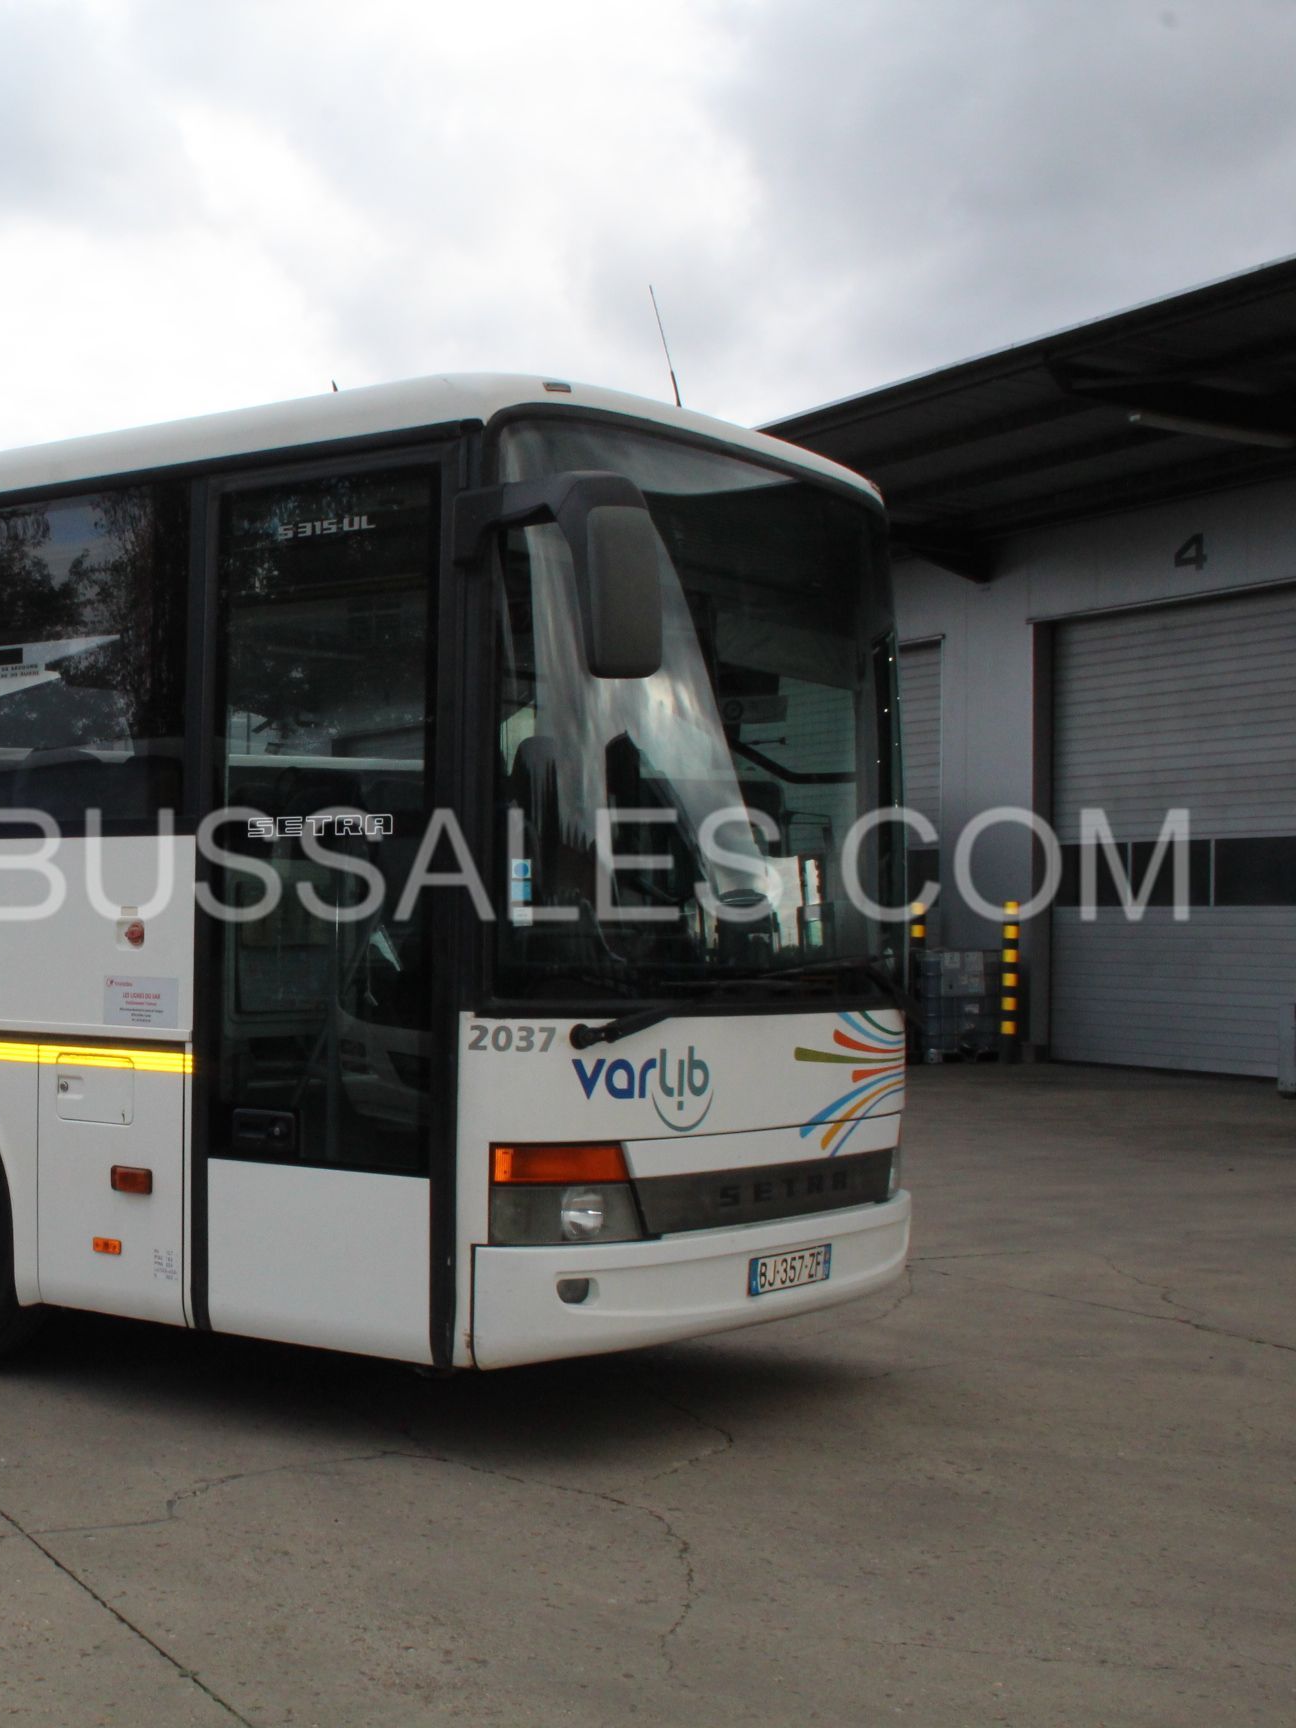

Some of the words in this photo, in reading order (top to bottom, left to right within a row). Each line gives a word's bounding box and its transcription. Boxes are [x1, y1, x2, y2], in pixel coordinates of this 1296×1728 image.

[278, 524, 294, 541] S
[297, 519, 337, 538] 315
[343, 515, 376, 532] UL
[1174, 532, 1208, 572] 4
[247, 813, 394, 838] SETRA
[467, 1024, 558, 1053] 2037
[719, 1169, 849, 1208] SETRA
